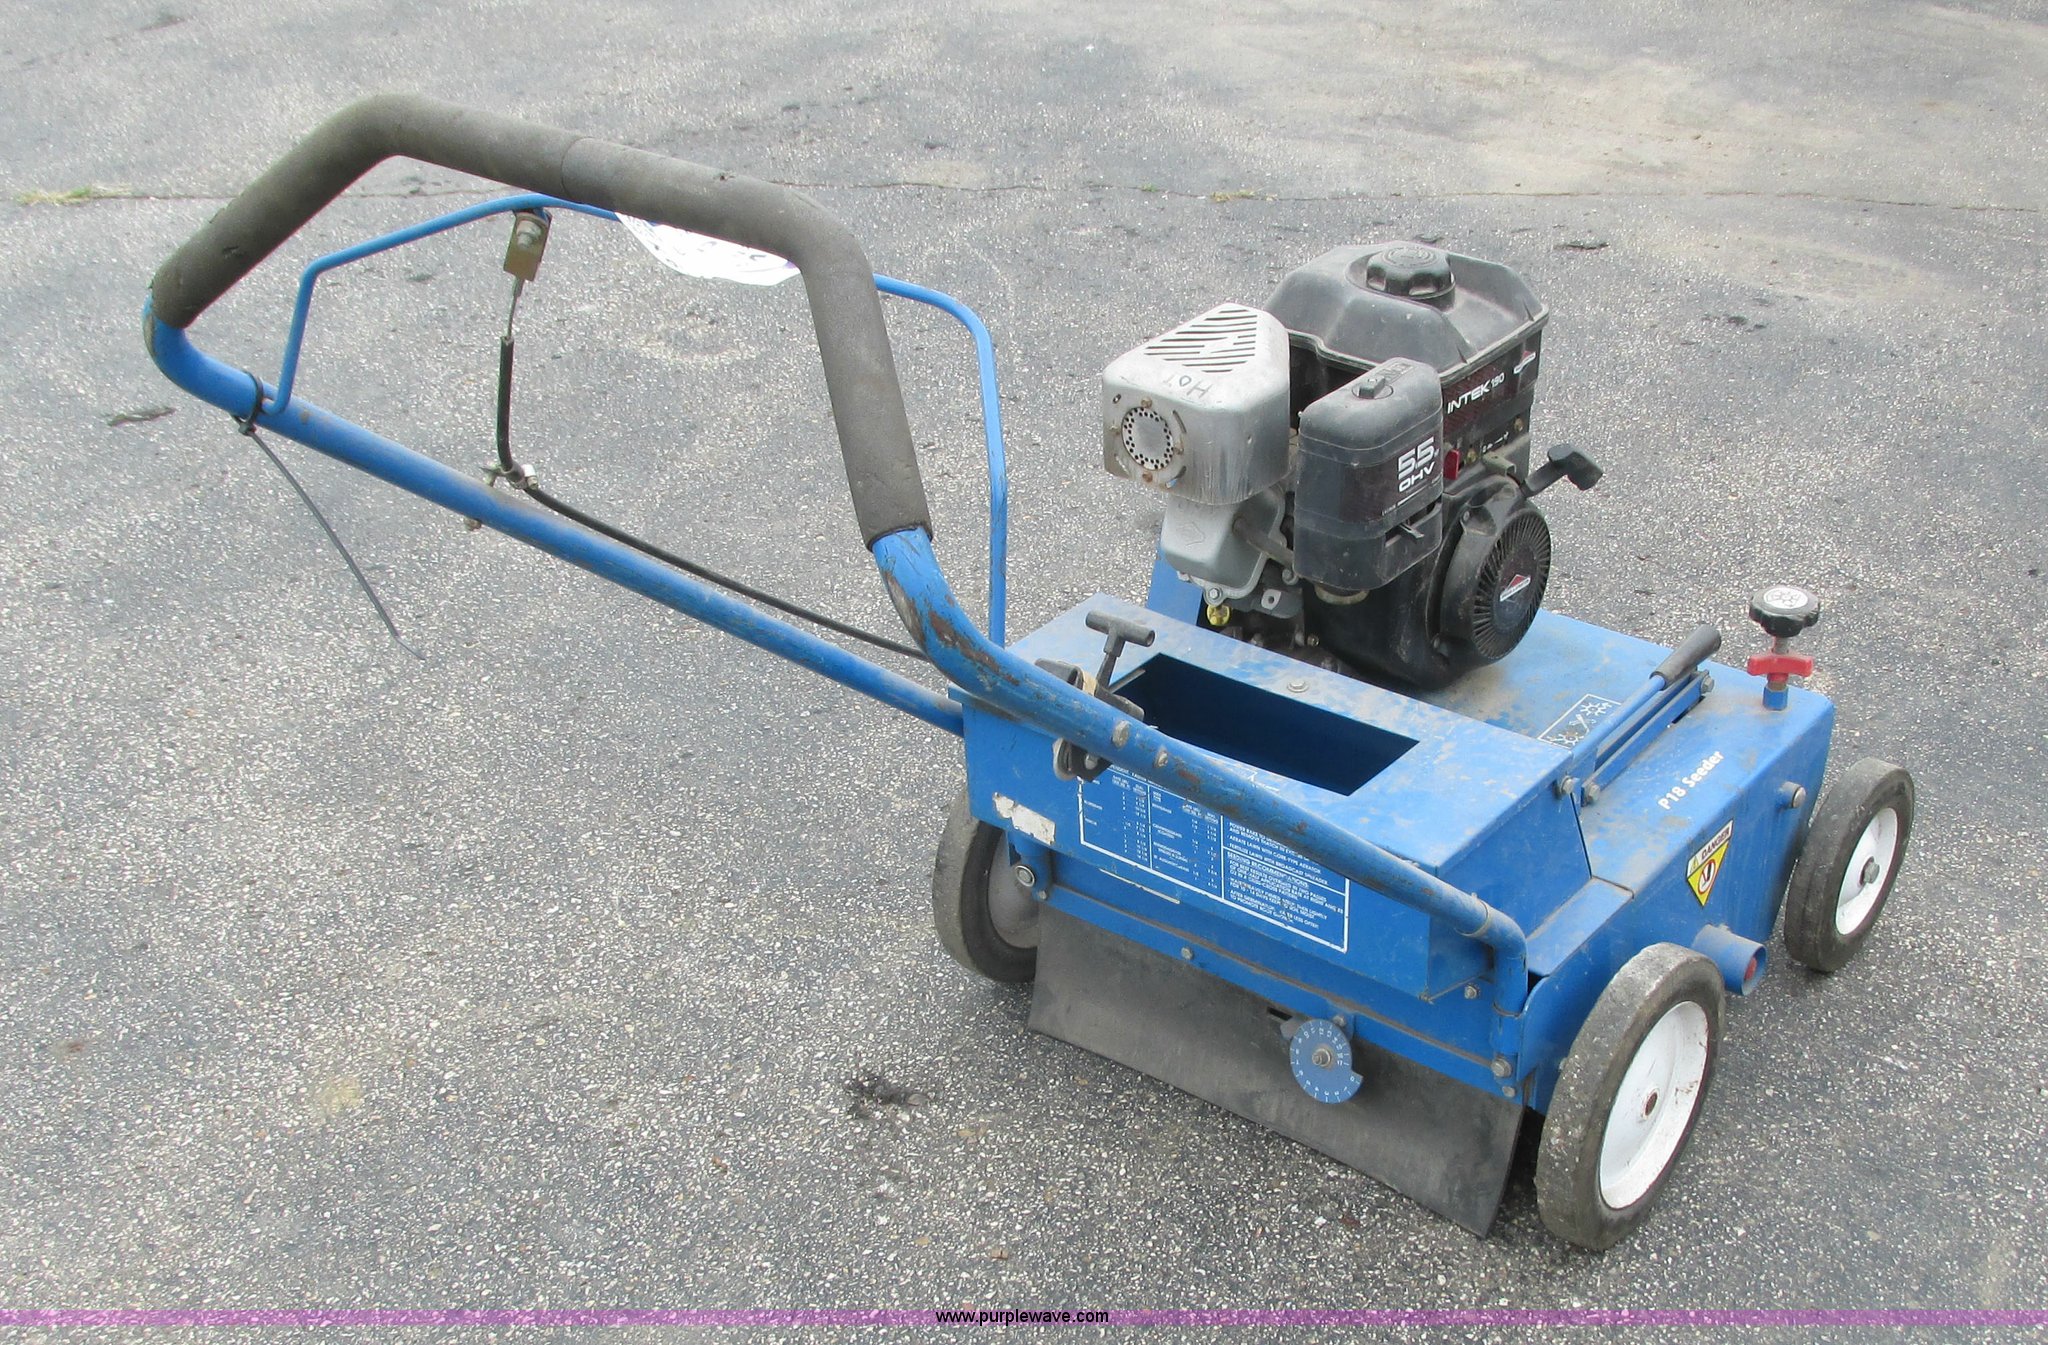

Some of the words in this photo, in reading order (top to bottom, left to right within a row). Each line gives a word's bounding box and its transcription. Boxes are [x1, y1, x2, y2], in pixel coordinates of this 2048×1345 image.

[1447, 380, 1490, 414] INTEK
[1398, 461, 1435, 493] OHV
[1658, 786, 1687, 810] P18
[1682, 751, 1724, 788] Seeder
[1701, 826, 1730, 860] DANGER
